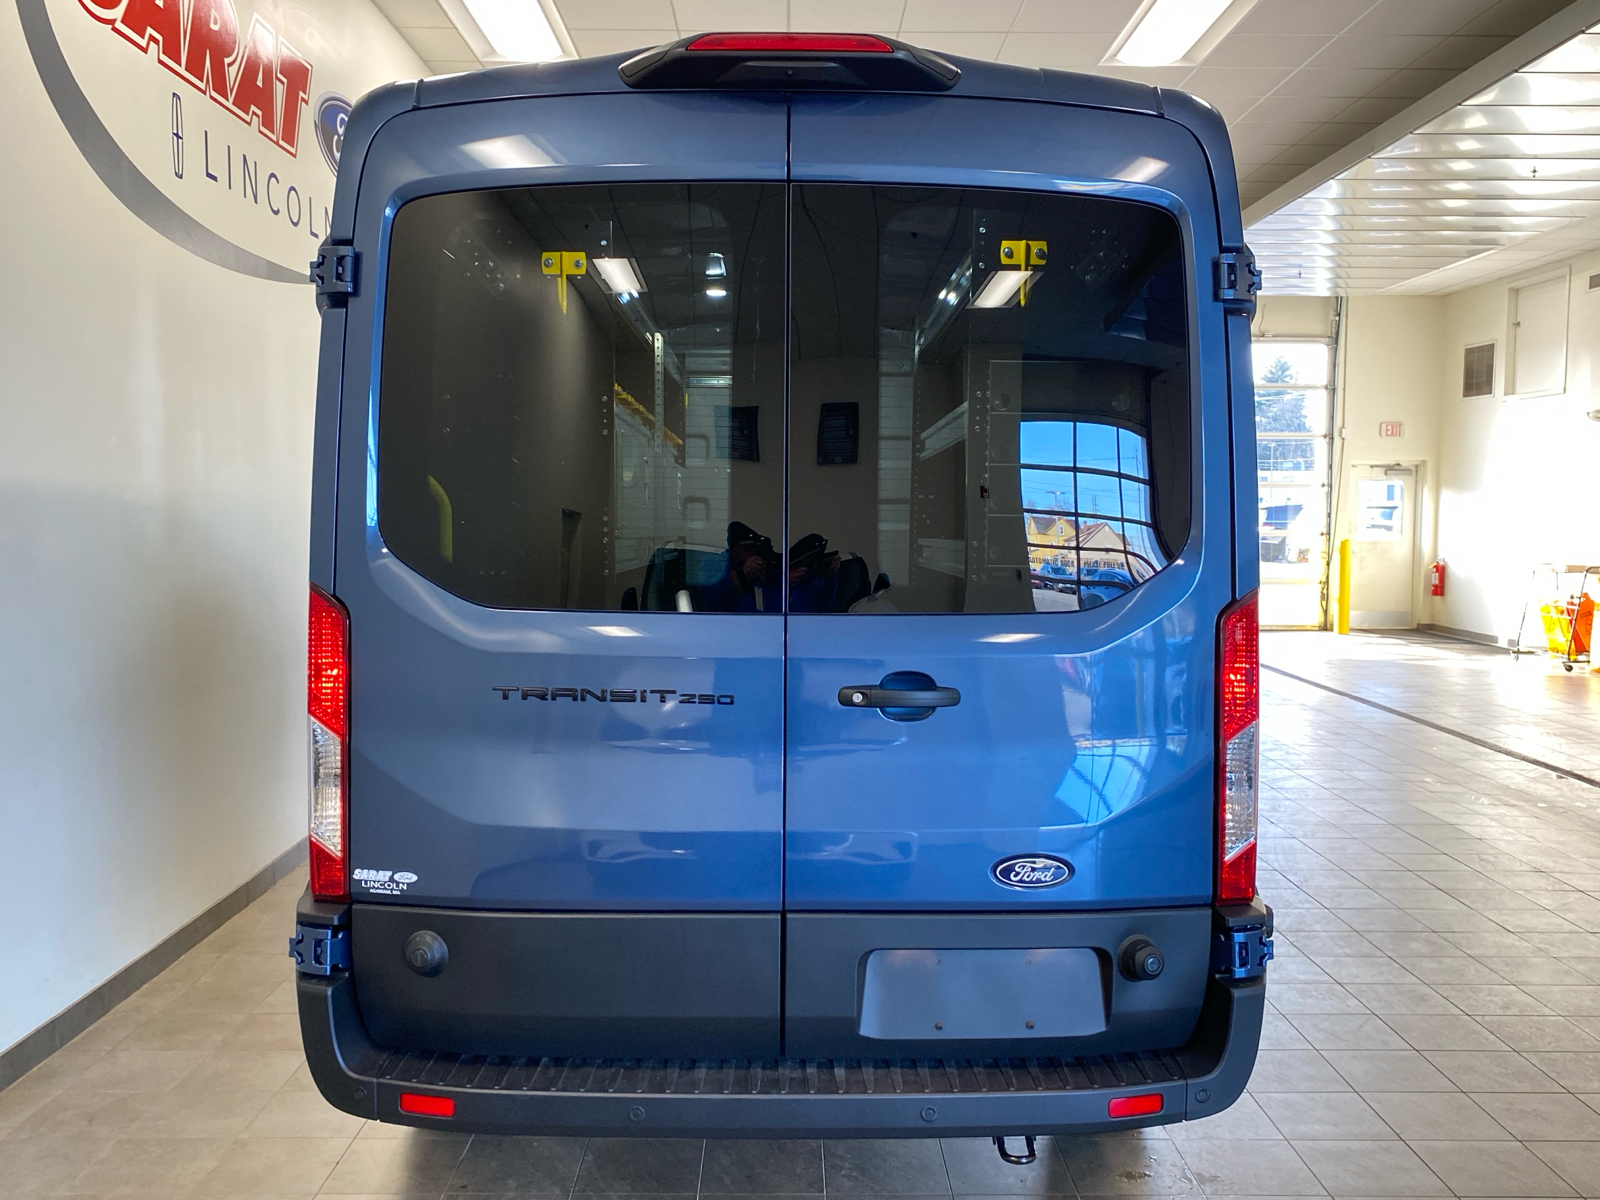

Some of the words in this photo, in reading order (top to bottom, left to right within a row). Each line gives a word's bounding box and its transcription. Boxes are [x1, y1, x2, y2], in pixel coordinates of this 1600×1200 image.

[77, 0, 313, 158] ARAT
[1385, 423, 1402, 437] EXIT
[492, 686, 677, 703] TRANSIT
[679, 693, 735, 705] 250
[352, 868, 393, 882] SARAT
[1010, 862, 1055, 882] Ford
[361, 880, 407, 890] LINCOLN
